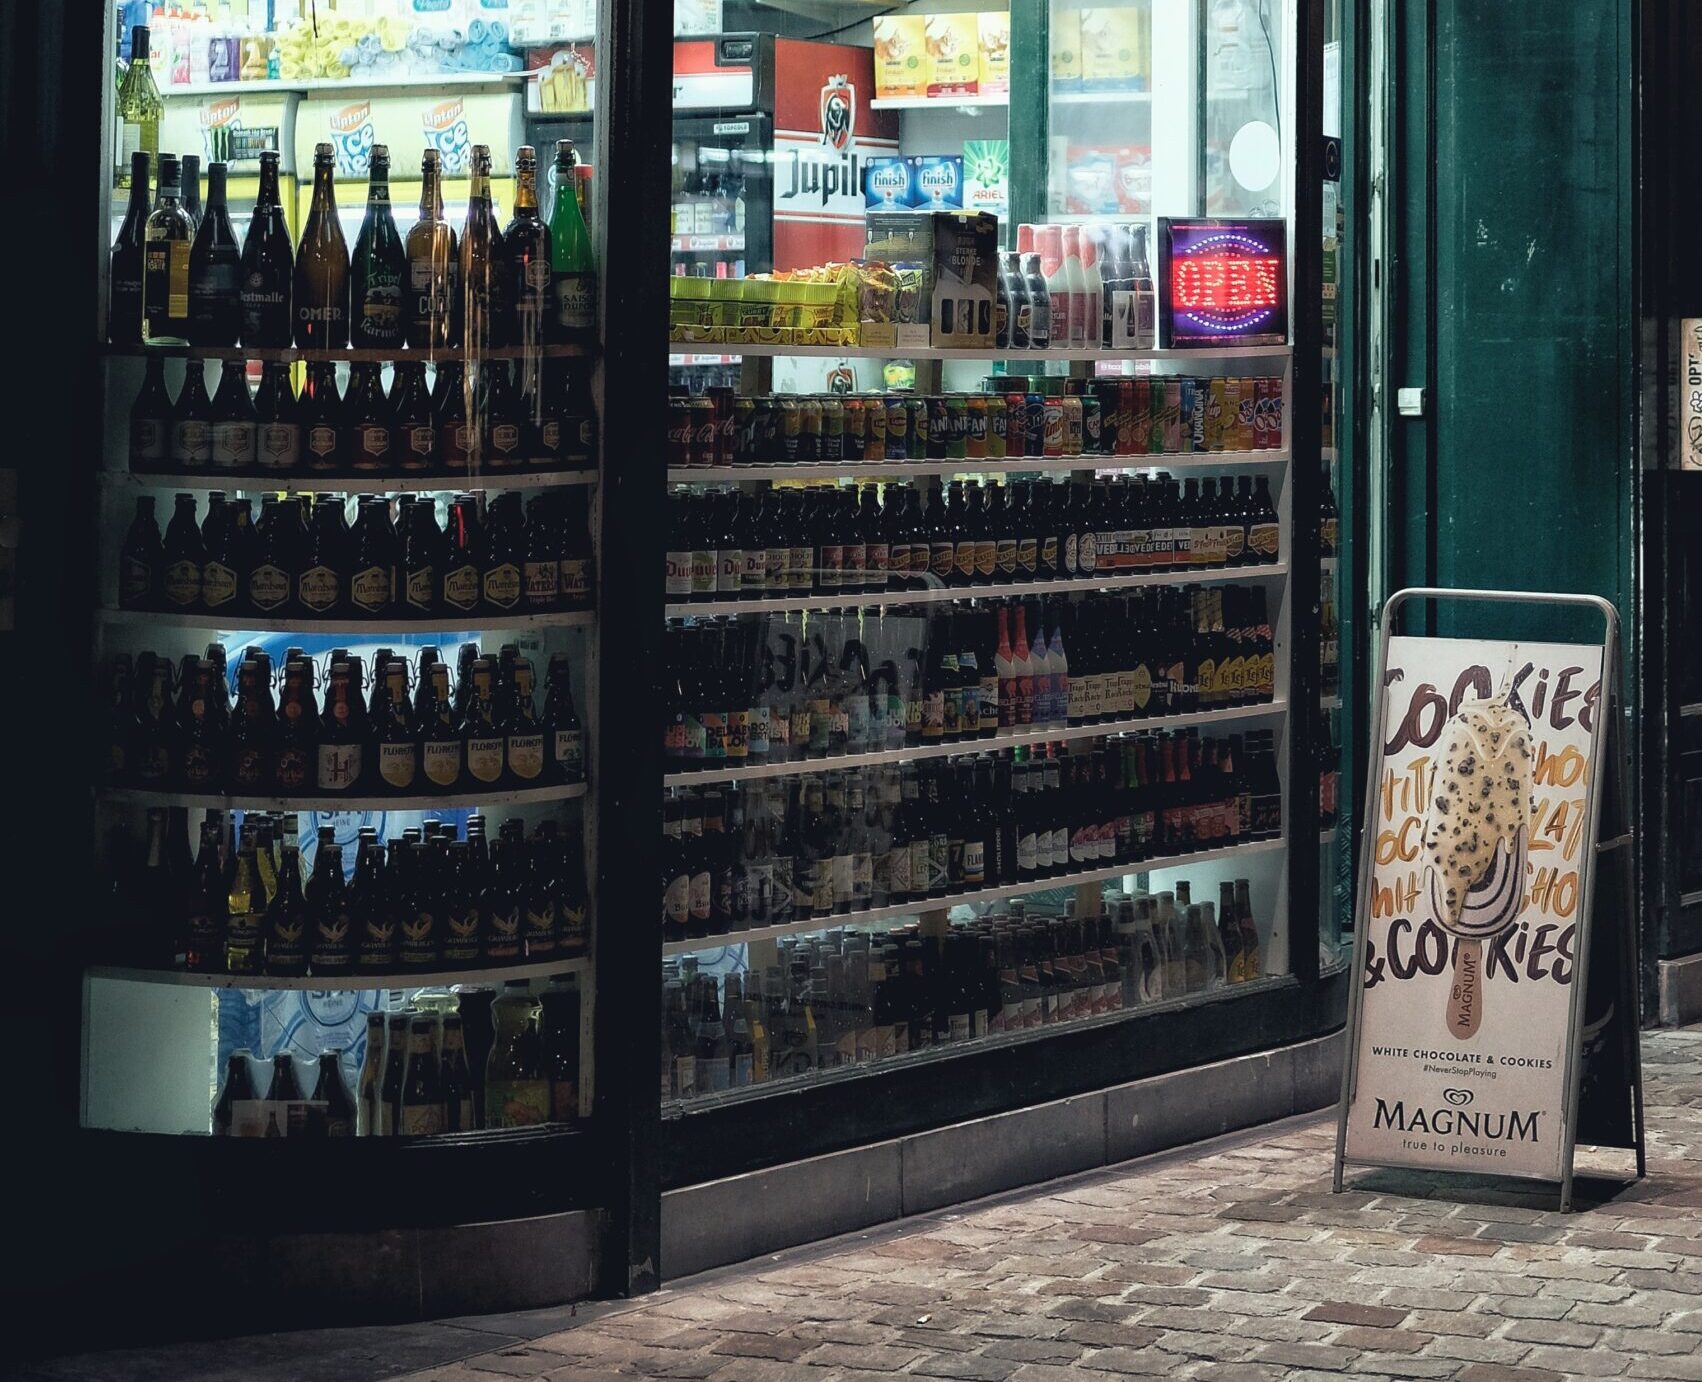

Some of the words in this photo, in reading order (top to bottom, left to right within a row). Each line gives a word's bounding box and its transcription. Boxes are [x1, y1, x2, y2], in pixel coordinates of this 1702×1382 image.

[330, 104, 371, 130] Lipton
[423, 102, 463, 128] Lipton
[873, 171, 905, 186] finish
[921, 169, 954, 185] finish
[972, 190, 1005, 200] ARIEL
[1176, 260, 1279, 306] OPEN
[1371, 1046, 1409, 1058] WHITE
[1413, 1048, 1482, 1064] CHOCOLATE
[1486, 1055, 1495, 1065] &
[1499, 1056, 1553, 1069] COOKIES
[1422, 1064, 1497, 1079] #NeverStopPlaying
[1372, 1096, 1541, 1143] MAGNUM
[1402, 1138, 1428, 1151] true
[1433, 1140, 1445, 1153] to
[1450, 1140, 1508, 1158] pleasure
